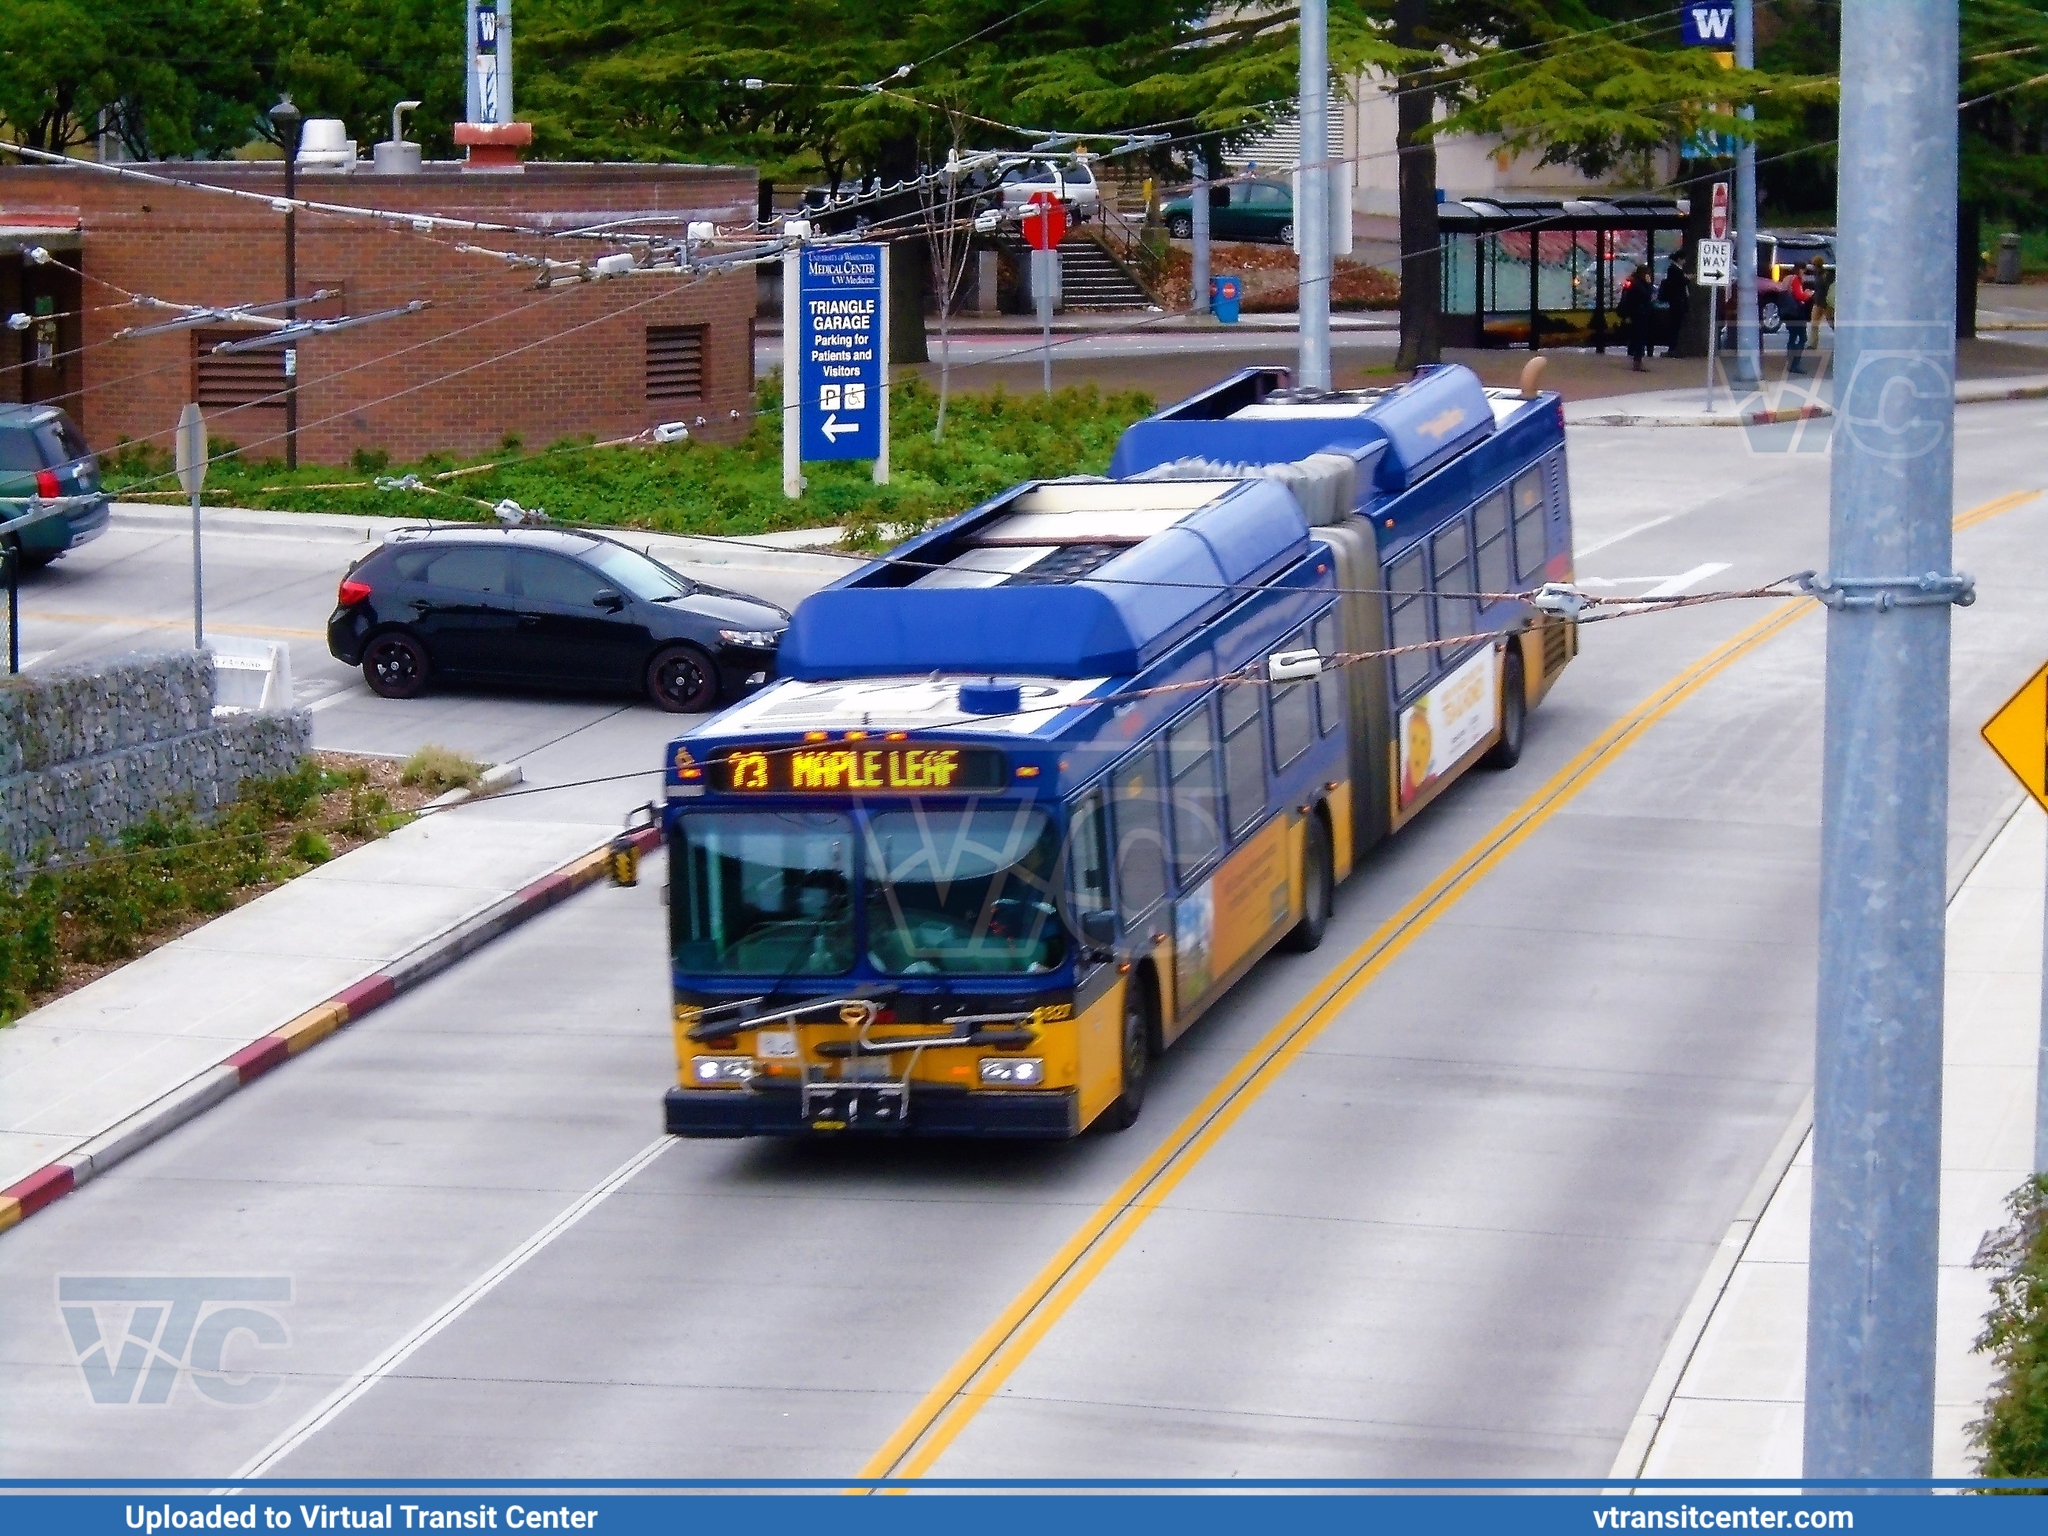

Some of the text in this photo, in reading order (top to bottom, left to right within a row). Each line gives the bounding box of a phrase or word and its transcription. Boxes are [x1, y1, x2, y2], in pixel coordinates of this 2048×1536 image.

[1692, 8, 1733, 38] W
[1703, 244, 1727, 256] ONE
[809, 261, 875, 275] MEDICAL CENTER
[1703, 257, 1726, 267] WAY
[809, 299, 875, 315] TRIANGLE
[813, 315, 870, 331] GARAGE
[814, 333, 869, 347] Parking for
[811, 348, 873, 362] Patients and
[823, 365, 861, 377] Visitors
[826, 389, 836, 406] P
[728, 750, 960, 788] 73 MAPLE LEAF
